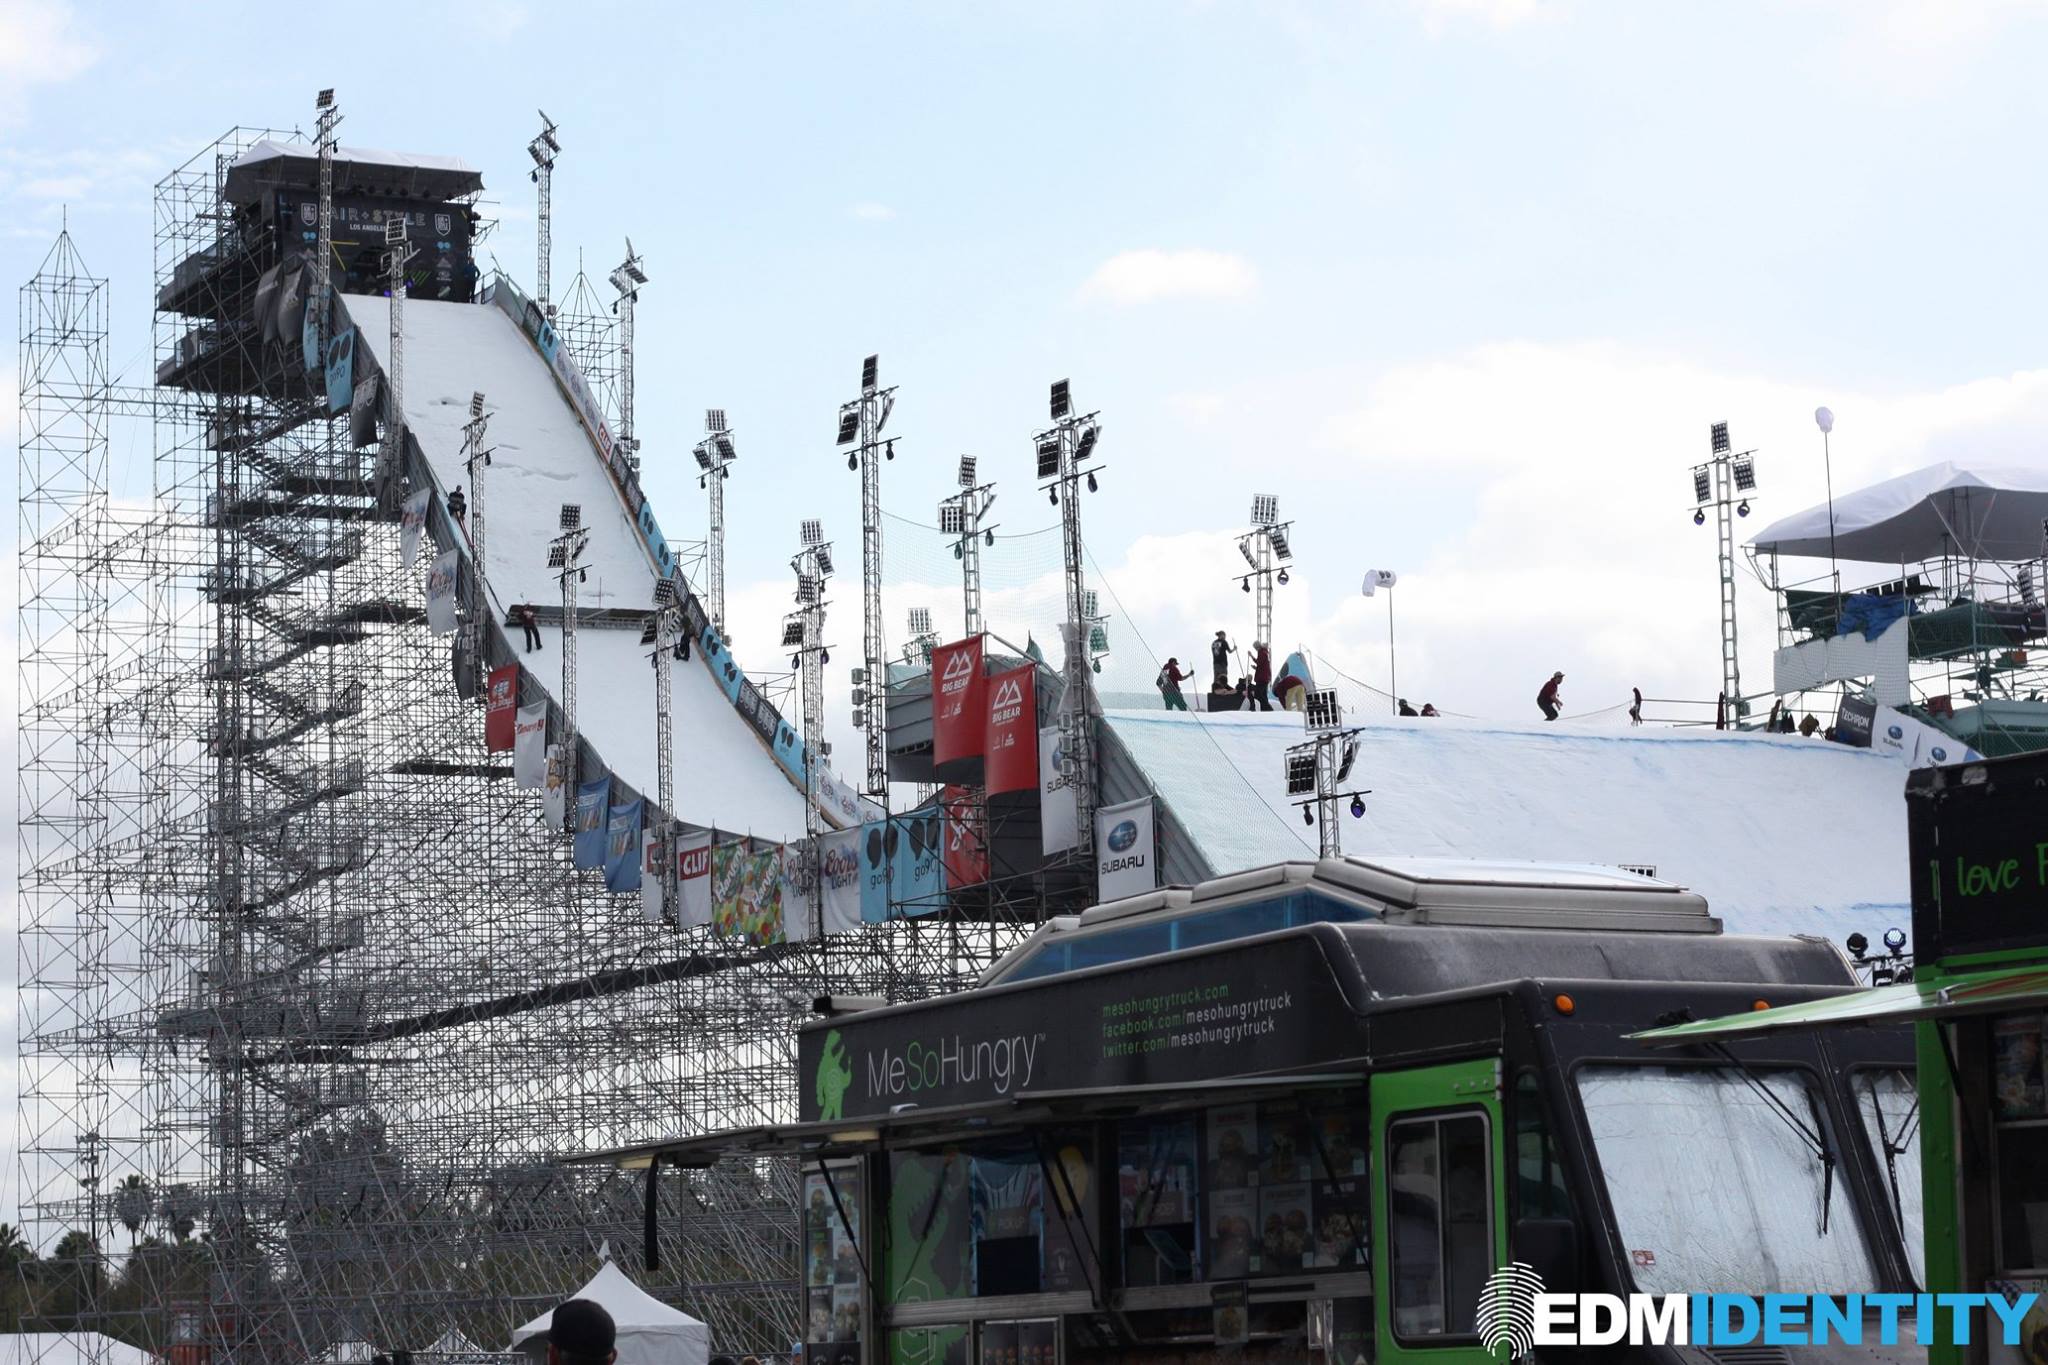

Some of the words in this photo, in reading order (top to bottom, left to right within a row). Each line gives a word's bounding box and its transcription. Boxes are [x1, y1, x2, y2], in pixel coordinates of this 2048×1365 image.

[349, 223, 361, 231] LOS
[942, 681, 954, 693] BIG
[992, 711, 1003, 724] BIG
[1003, 706, 1021, 720] BEAR
[1841, 707, 1870, 728] TECHRON
[682, 850, 708, 876] CLIF
[914, 857, 937, 882] go90
[1101, 854, 1145, 875] SUBARU
[1957, 856, 2020, 896] love
[1103, 983, 1230, 1017] mesohungrytruck.com
[1103, 991, 1292, 1038] facebook.com/mesohungrytruck
[1103, 1015, 1276, 1059] twitter.com/mesohungrytruck
[868, 1034, 1038, 1097] MeSoHungry
